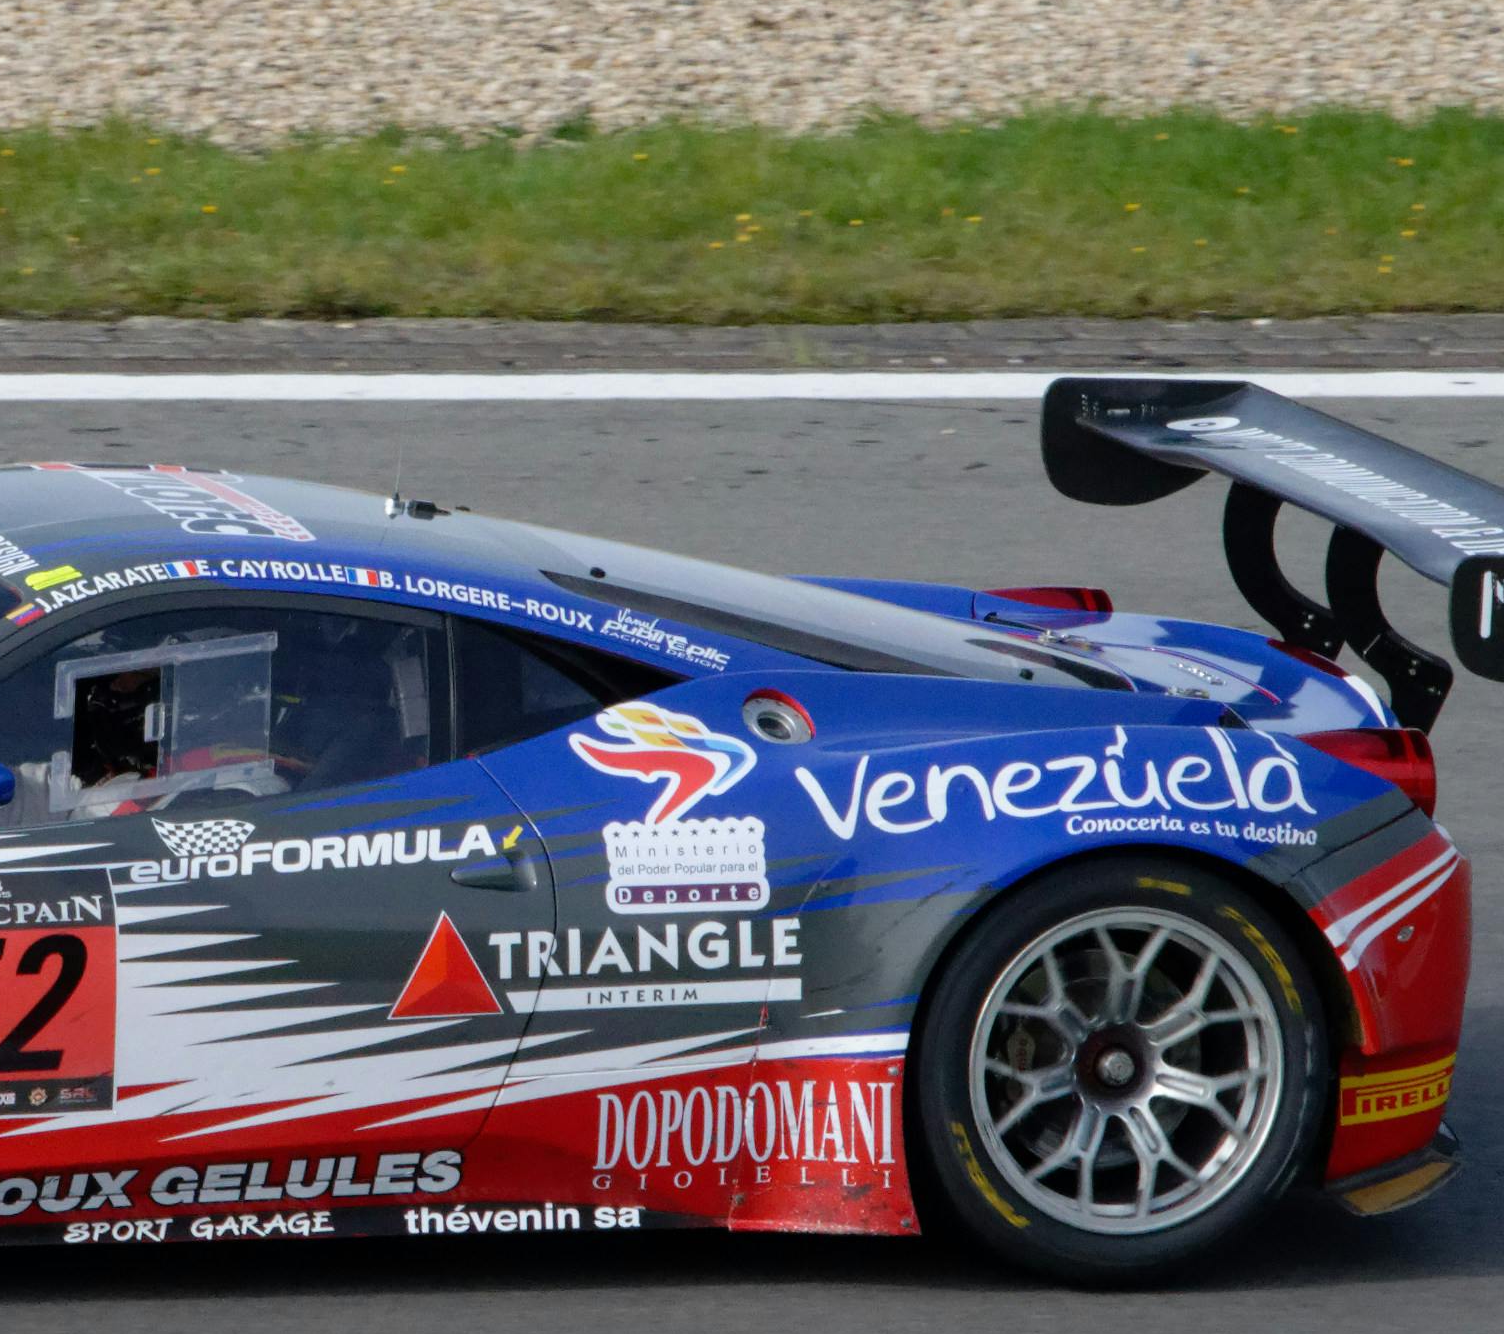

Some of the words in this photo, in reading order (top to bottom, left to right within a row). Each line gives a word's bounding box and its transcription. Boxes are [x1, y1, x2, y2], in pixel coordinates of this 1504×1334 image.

[197, 559, 219, 578] E.
[220, 559, 347, 584] CAYROLLE
[379, 570, 402, 591] B.
[794, 725, 1317, 840] Venezuela
[1065, 814, 1185, 836] Conocerla
[1189, 821, 1211, 835] es
[1216, 820, 1239, 839] tu
[1243, 822, 1318, 846] destino
[130, 824, 497, 884] euroFORMULA
[614, 843, 757, 859] Ministerio
[617, 864, 635, 876] del
[638, 864, 671, 875] Poder
[674, 862, 717, 877] Popular
[720, 864, 745, 876] para
[748, 862, 759, 872] el
[617, 885, 761, 905] Deporte
[487, 917, 803, 980] TRIANGLE
[586, 988, 699, 1005] INTERIM
[1342, 1064, 1453, 1117] PIRELL
[592, 1080, 896, 1170] DOPODOMANI
[150, 1150, 464, 1207] GELULES
[592, 1166, 892, 1190] GIOIELLI
[63, 1217, 174, 1244] SPORT
[191, 1211, 336, 1241] GARAGE
[403, 1202, 581, 1235] thévenin
[594, 1206, 642, 1229] sa
